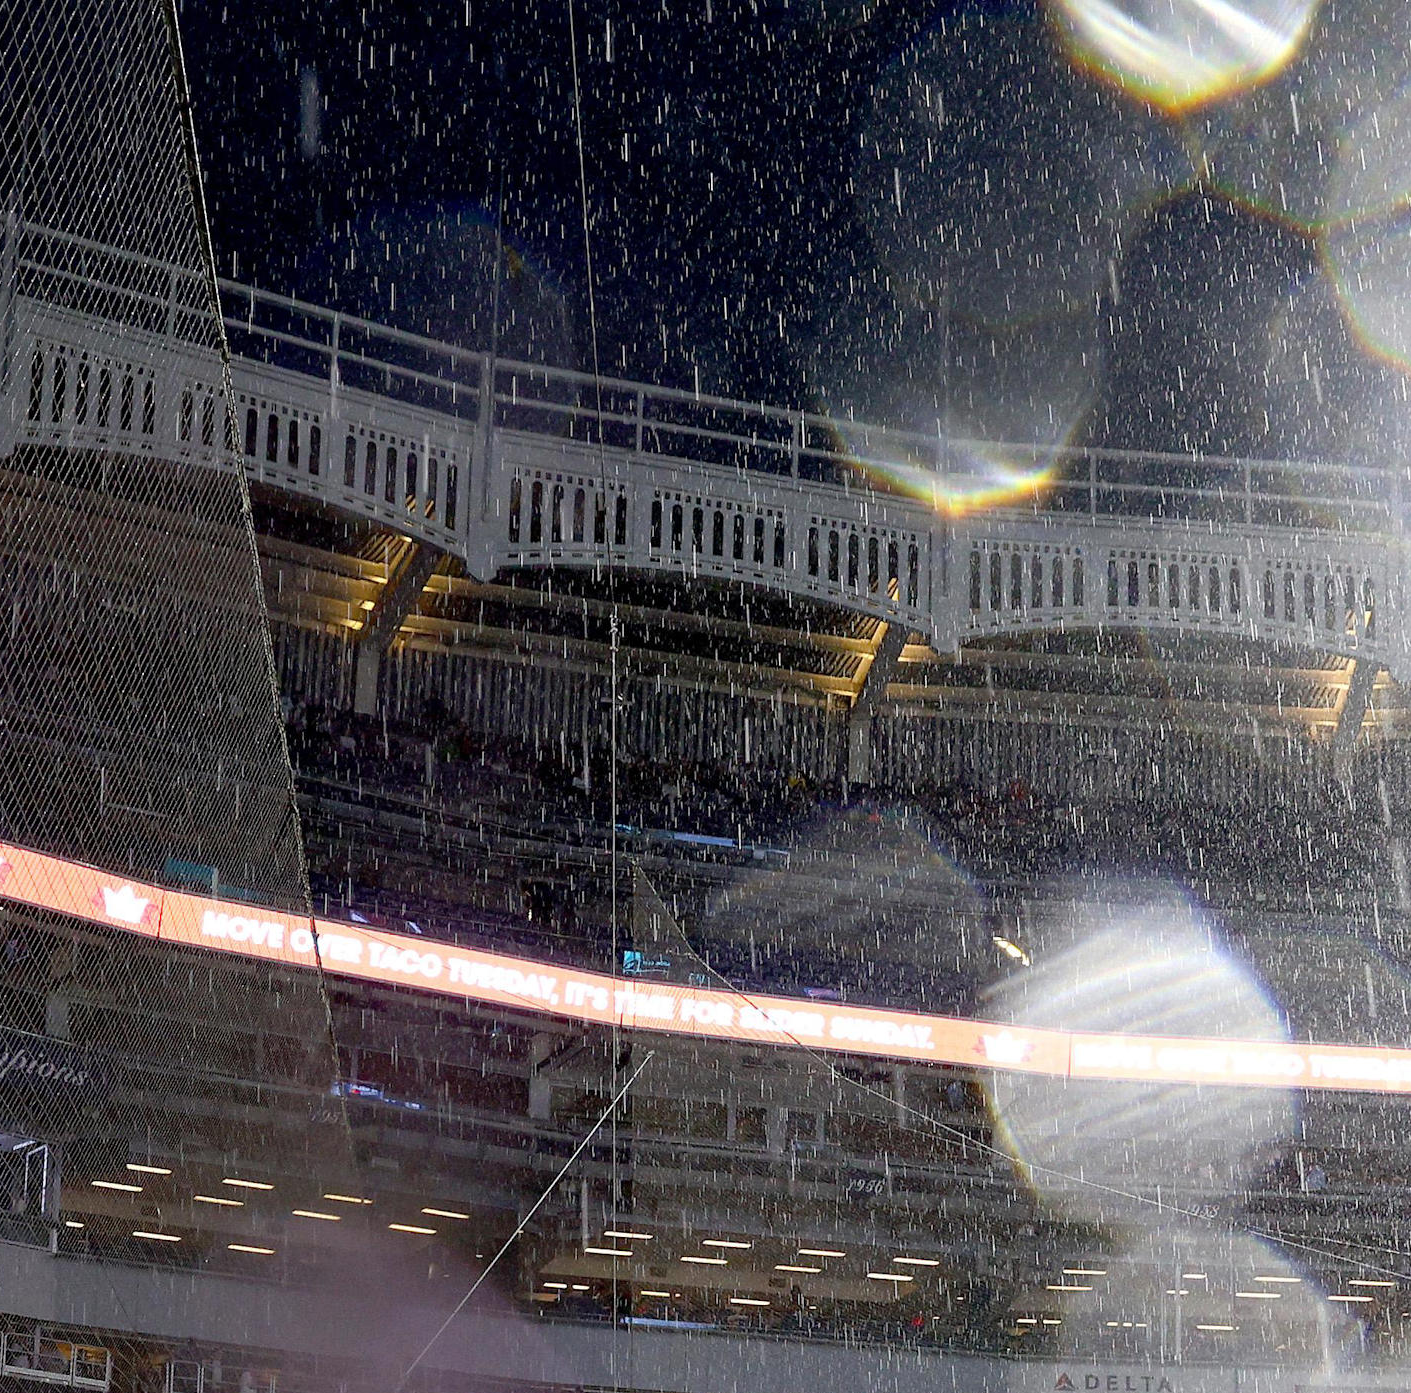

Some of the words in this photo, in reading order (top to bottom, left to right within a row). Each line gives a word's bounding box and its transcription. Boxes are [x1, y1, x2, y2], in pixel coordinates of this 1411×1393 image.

[202, 911, 283, 949] MOVE
[290, 927, 362, 964] OVER
[369, 942, 442, 977] TACO
[449, 958, 559, 1005] TUESDAY,
[565, 980, 608, 1011] IT'S
[615, 990, 673, 1019] TIME
[682, 998, 732, 1026] FOR
[1085, 1374, 1172, 1393] DELTA
